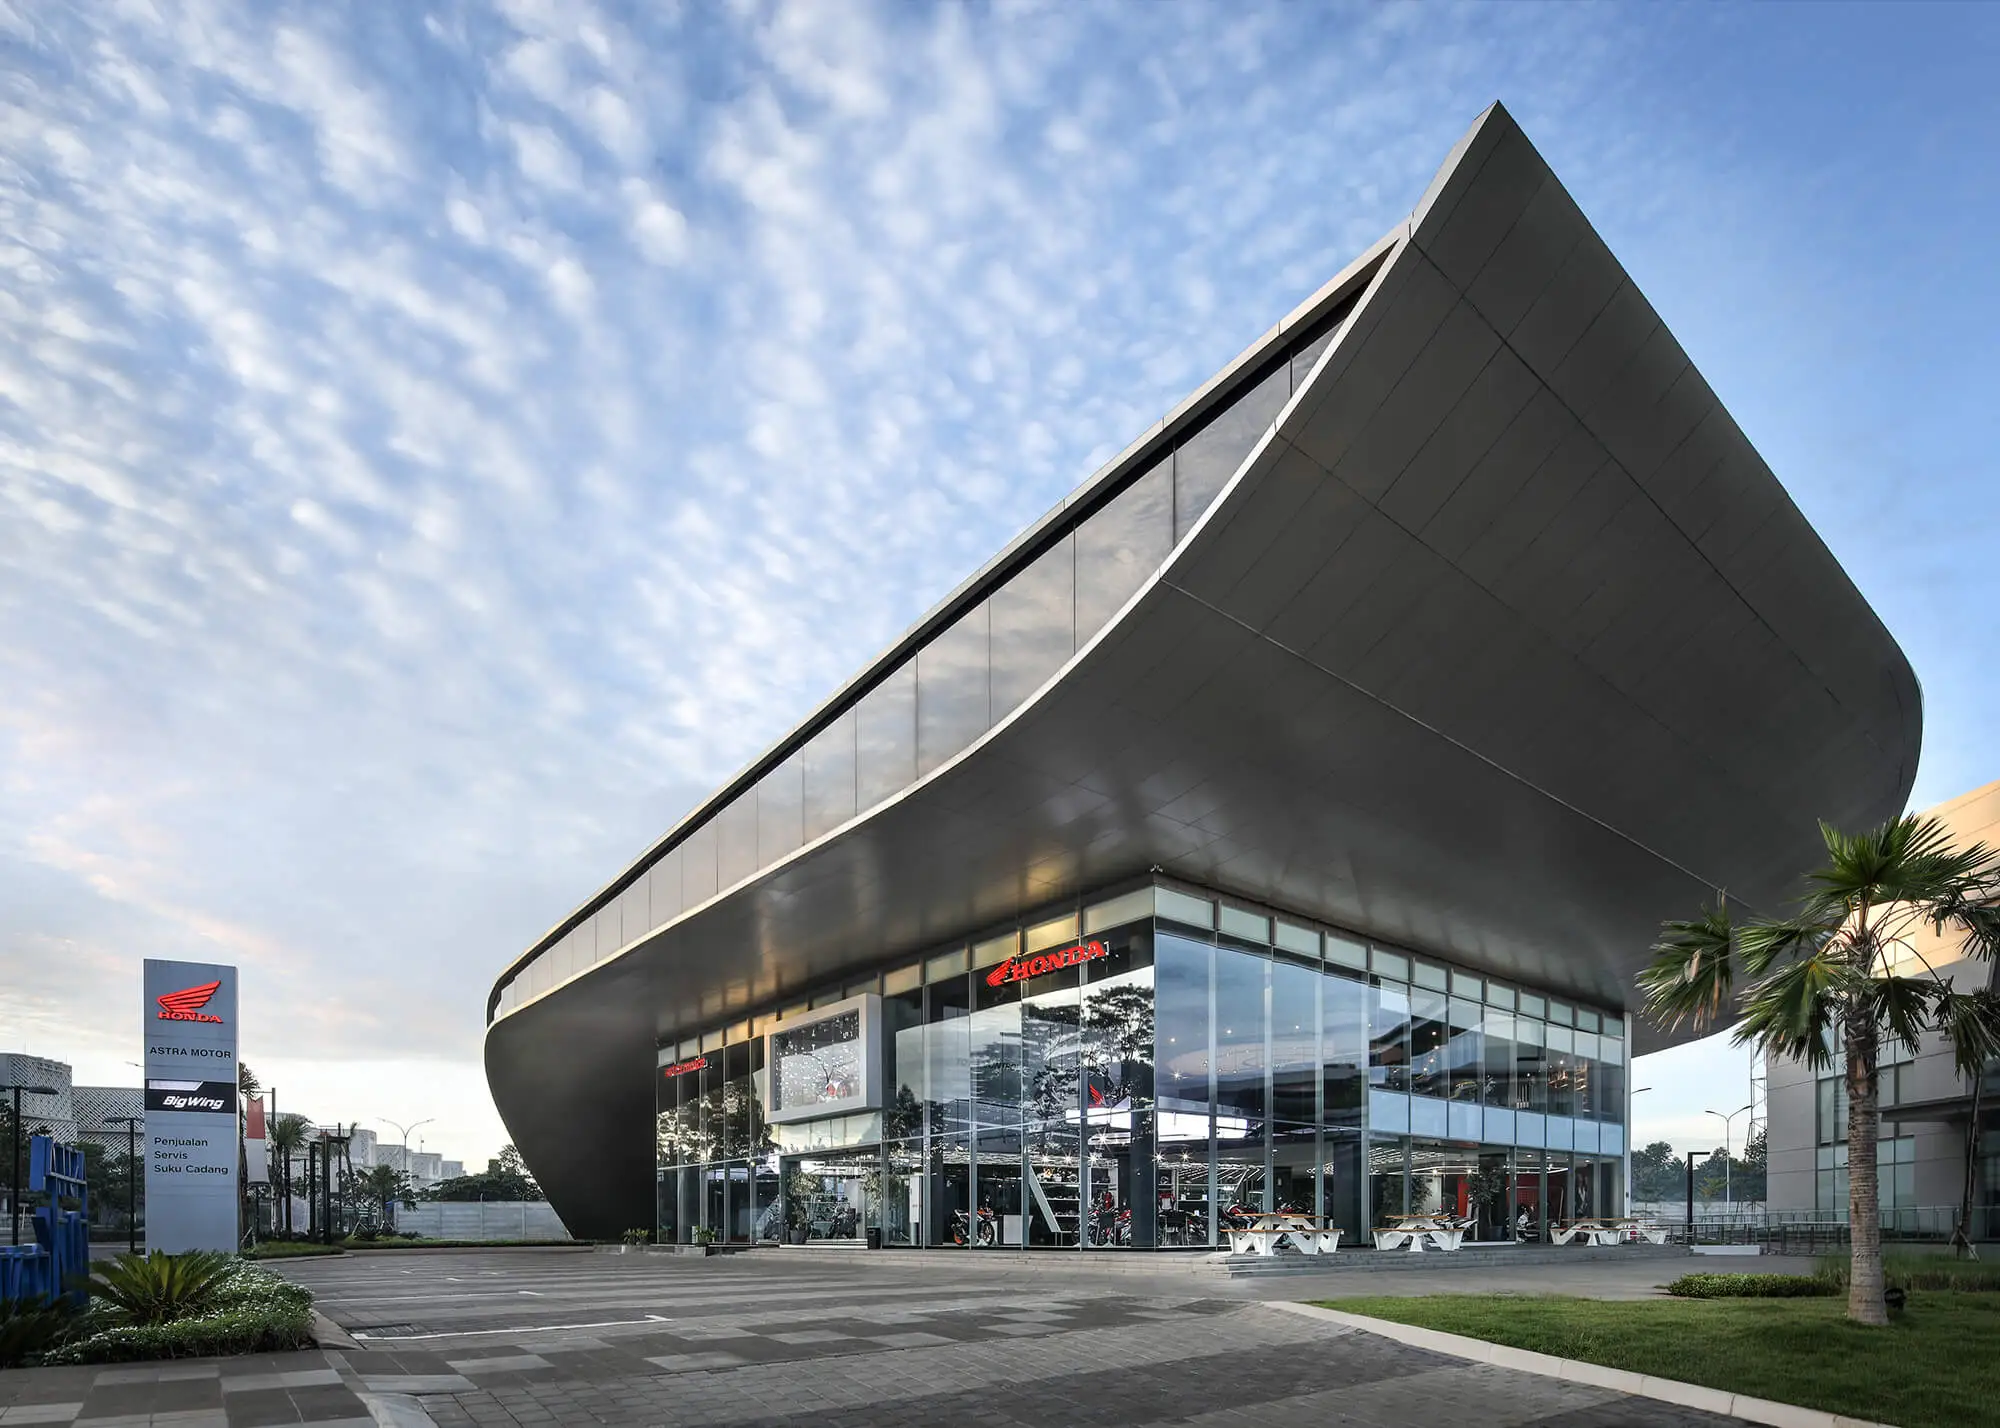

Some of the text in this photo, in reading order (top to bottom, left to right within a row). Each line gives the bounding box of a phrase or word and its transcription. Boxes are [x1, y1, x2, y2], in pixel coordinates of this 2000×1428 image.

[1012, 940, 1105, 981] HONDA
[158, 1011, 223, 1023] HONDA
[149, 1046, 232, 1059] ASTRA MOTOR
[163, 1095, 224, 1109] BigWing
[154, 1137, 208, 1147] Penjualan
[154, 1150, 188, 1159] Servis
[154, 1164, 229, 1175] Suku Cadang
